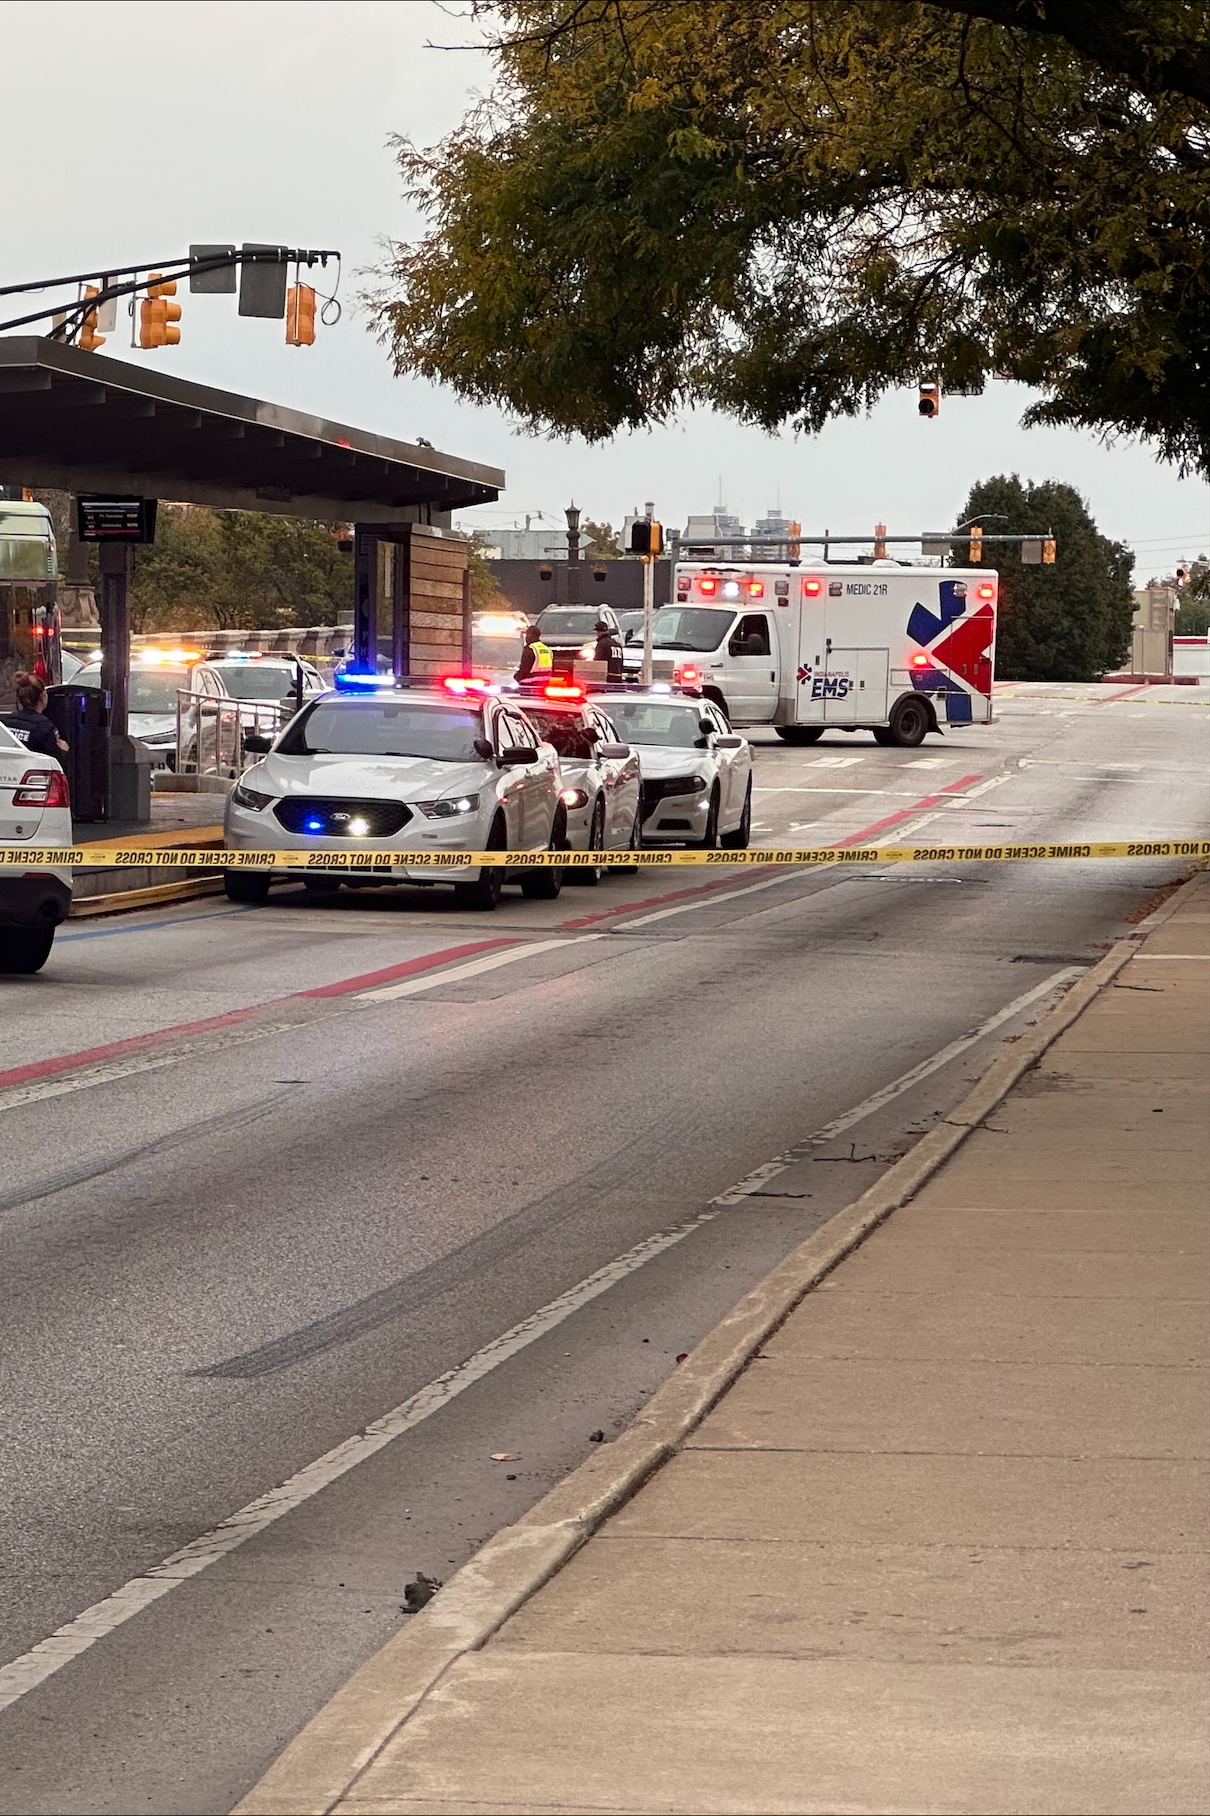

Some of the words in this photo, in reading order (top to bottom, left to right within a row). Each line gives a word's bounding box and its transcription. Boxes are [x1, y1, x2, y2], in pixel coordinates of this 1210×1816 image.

[846, 584, 871, 595] MEDIC
[873, 584, 887, 595] 21R
[811, 678, 849, 698] EMS
